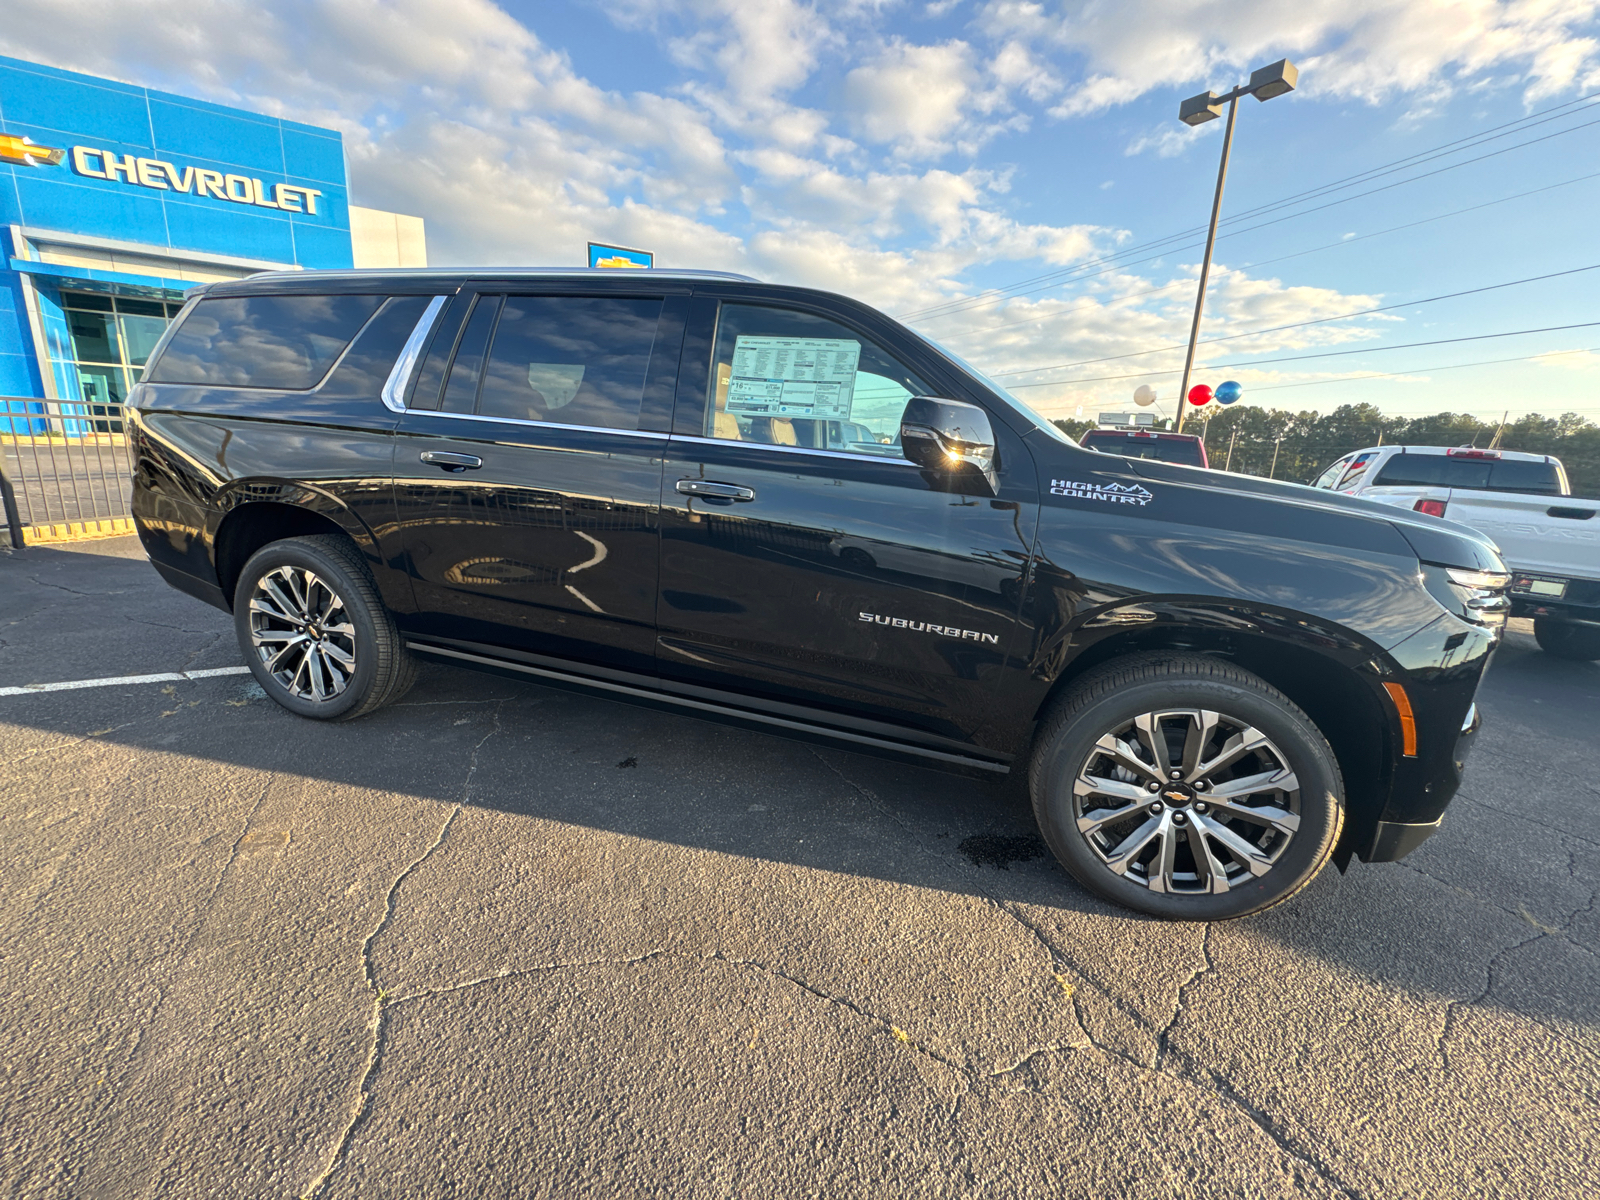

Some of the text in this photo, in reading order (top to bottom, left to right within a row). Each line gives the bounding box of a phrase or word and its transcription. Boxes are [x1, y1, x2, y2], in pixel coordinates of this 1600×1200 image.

[72, 145, 321, 215] CHEVROLET
[1050, 479, 1101, 492] HIGH
[1050, 487, 1152, 506] COUNTRY
[858, 612, 999, 645] SUBURBAN
